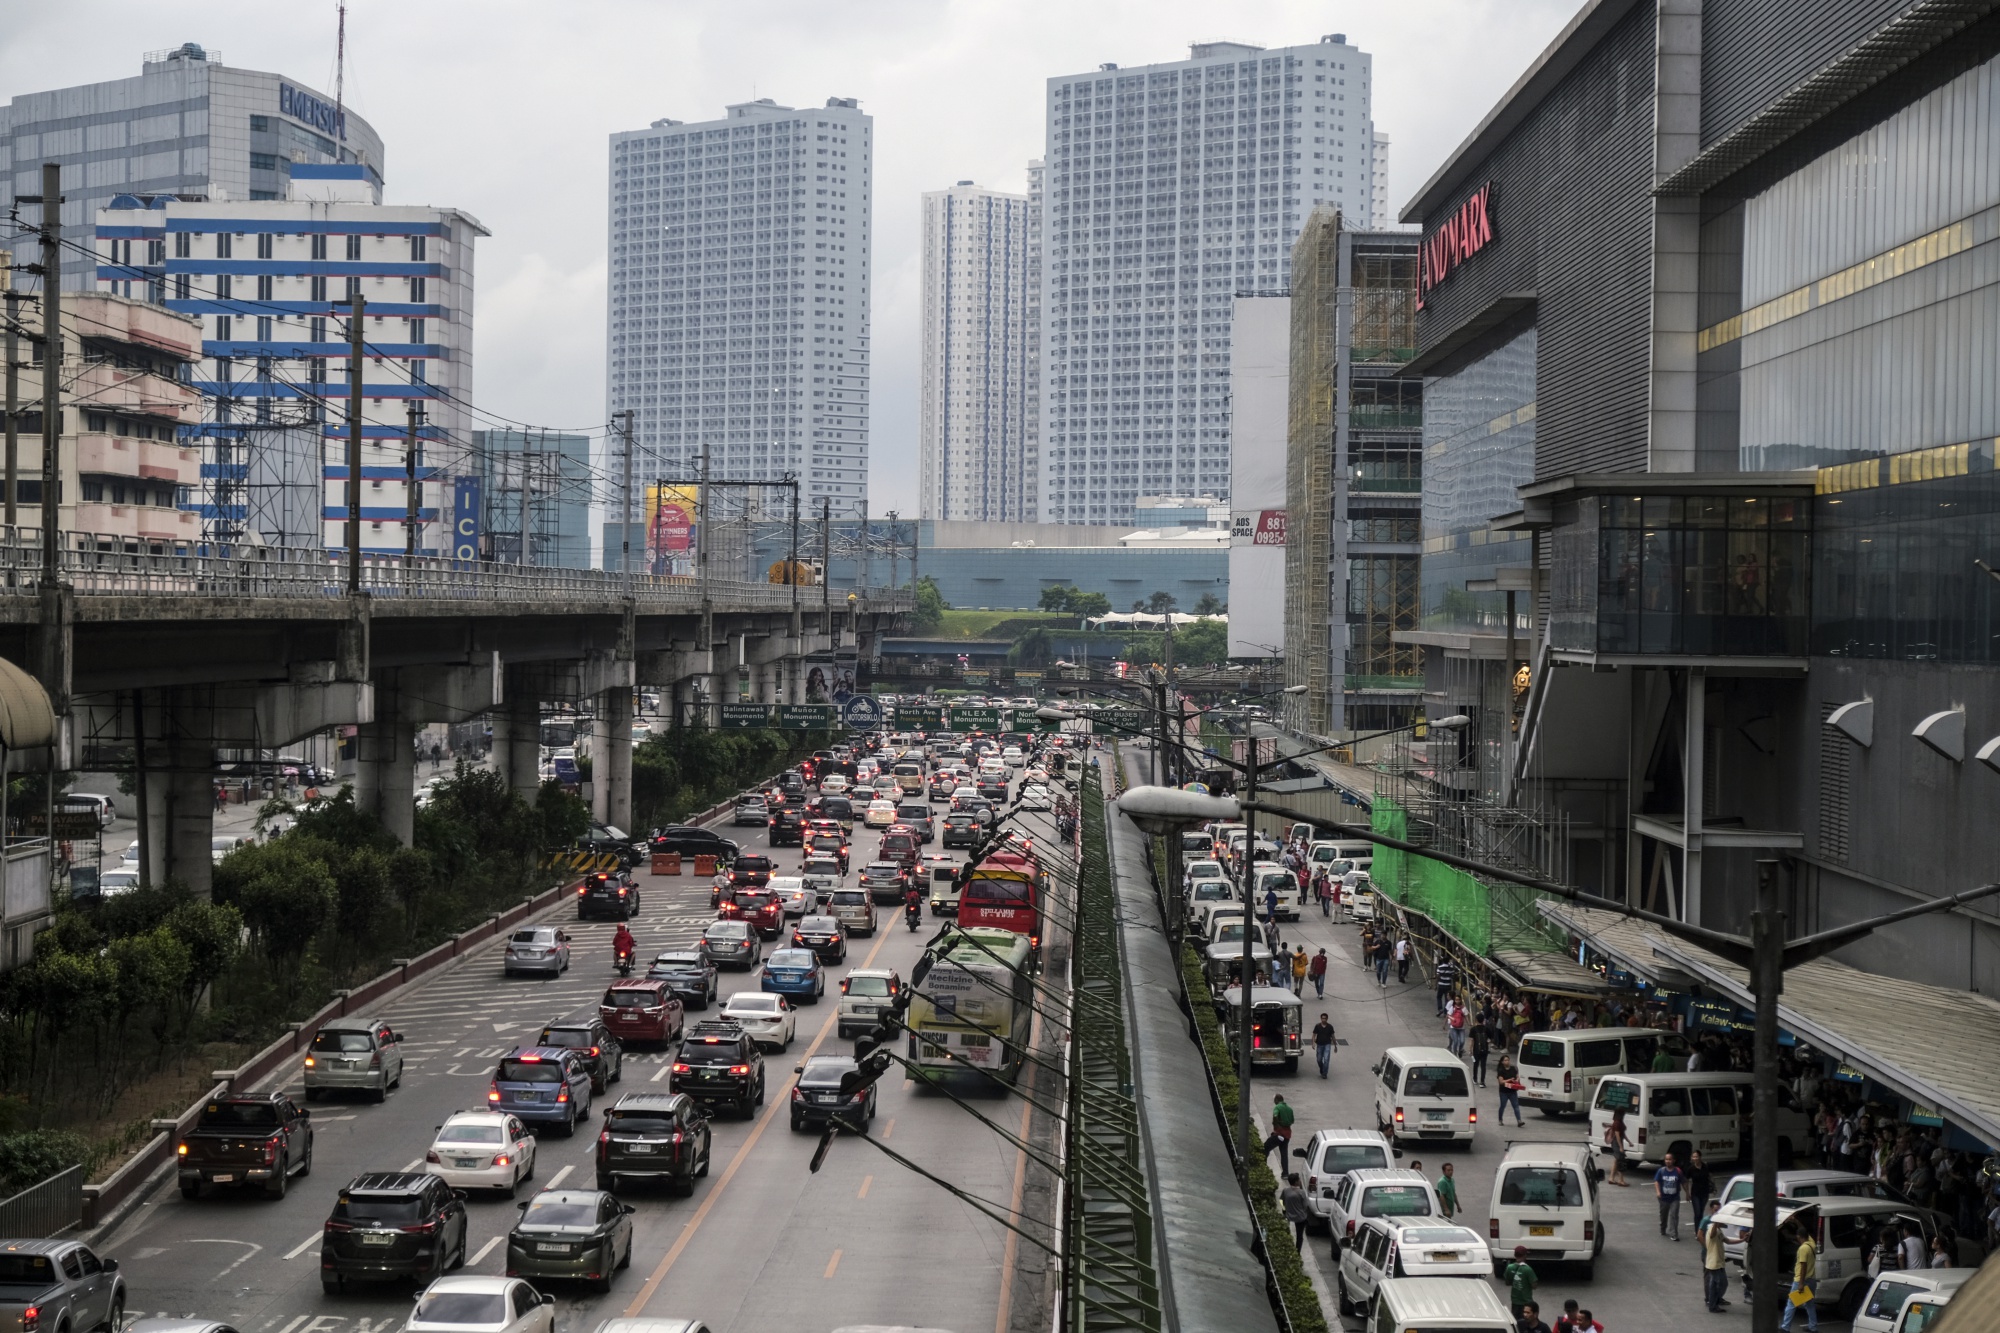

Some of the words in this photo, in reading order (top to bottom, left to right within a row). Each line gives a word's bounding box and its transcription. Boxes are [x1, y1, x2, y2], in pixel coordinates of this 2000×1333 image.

[280, 82, 347, 141] EMERSON
[1416, 180, 1493, 311] LANDMARK
[1236, 518, 1250, 526] ADS
[1232, 528, 1253, 536] SPACE
[929, 973, 973, 984] Meclizine
[929, 982, 971, 991] Bonamine
